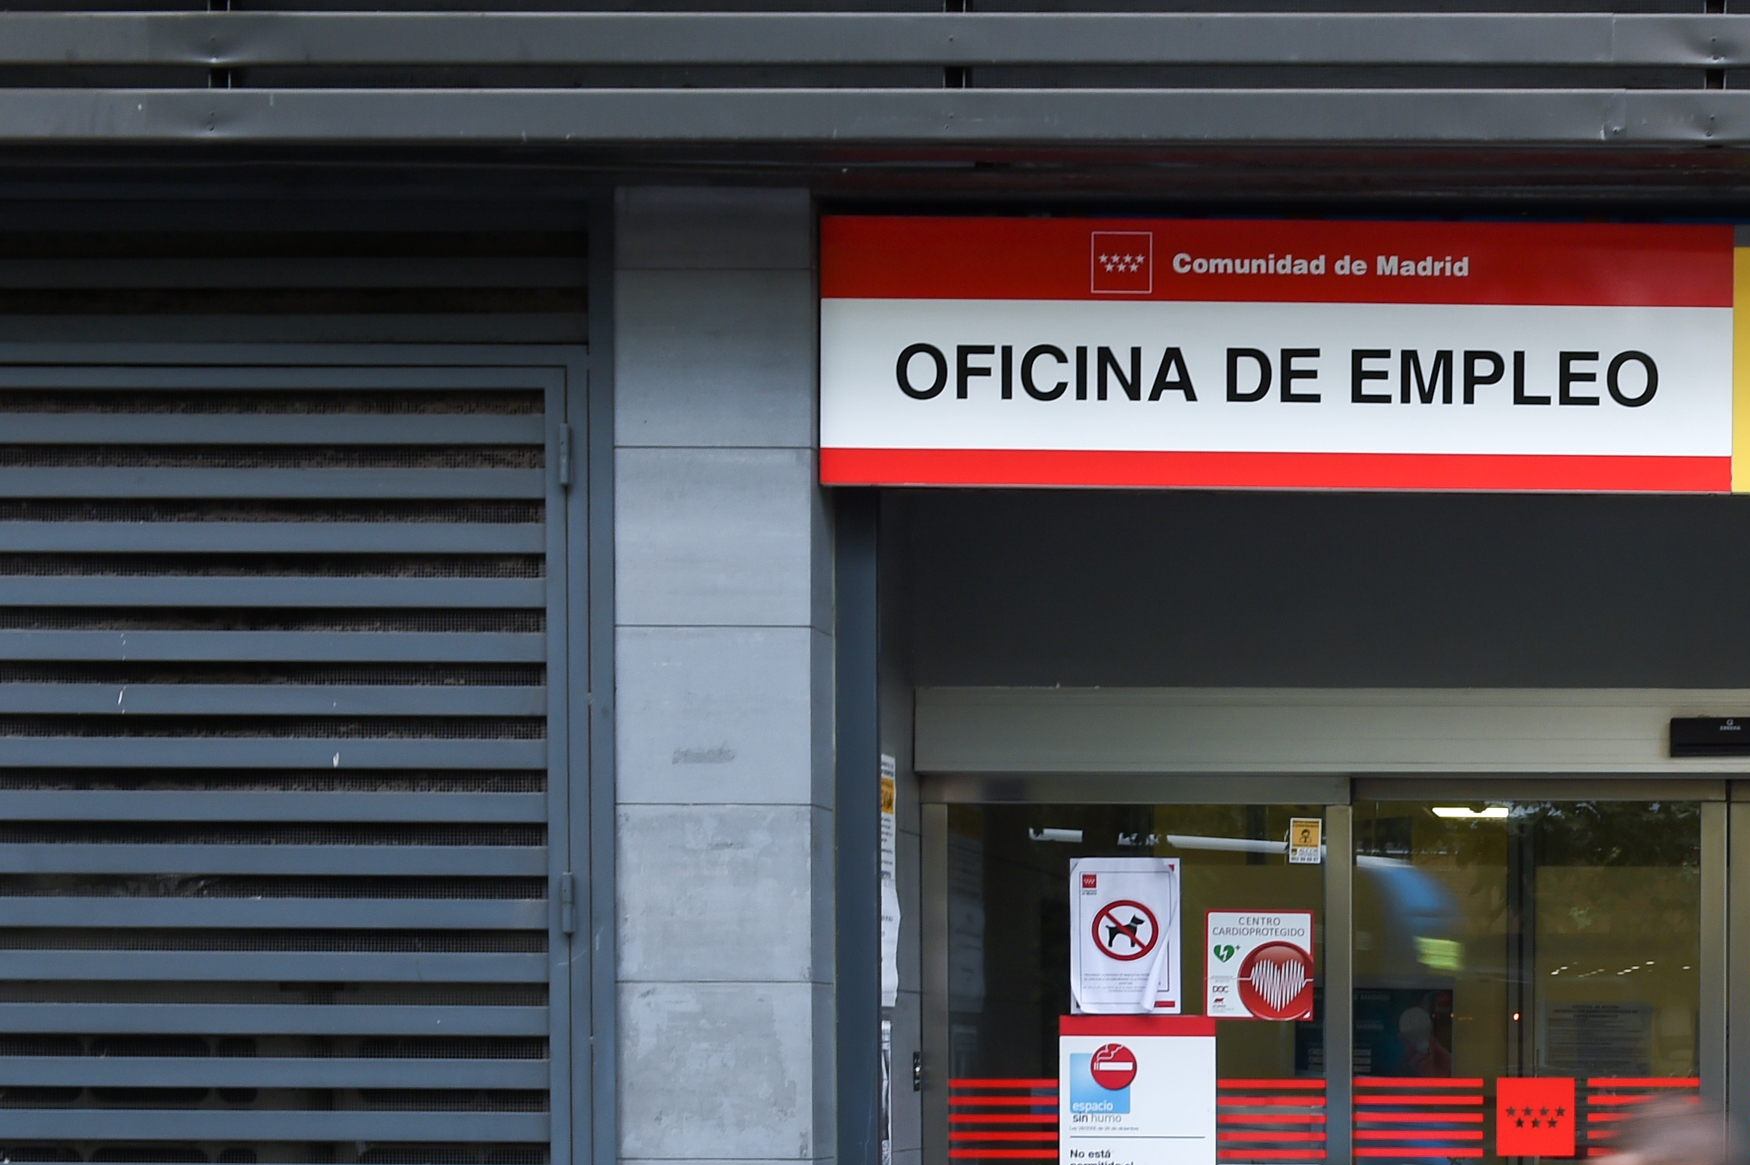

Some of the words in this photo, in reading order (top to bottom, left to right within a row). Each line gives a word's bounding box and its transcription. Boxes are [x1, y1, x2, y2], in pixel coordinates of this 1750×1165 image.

[1172, 251, 1325, 277] Comunidad
[1334, 253, 1367, 277] de
[1377, 254, 1470, 278] Madrid
[896, 343, 1198, 403] OFICINA
[1227, 347, 1321, 404] DE
[1351, 348, 1660, 408] EMPLEO
[1238, 917, 1280, 926] CENTRO
[1212, 927, 1305, 937] CARDIOPROTEGIDO
[1072, 1100, 1114, 1112] espacio
[1072, 1113, 1088, 1123] sin
[1090, 1114, 1122, 1123] humo
[1070, 1150, 1085, 1158] No
[1088, 1149, 1111, 1159] está
